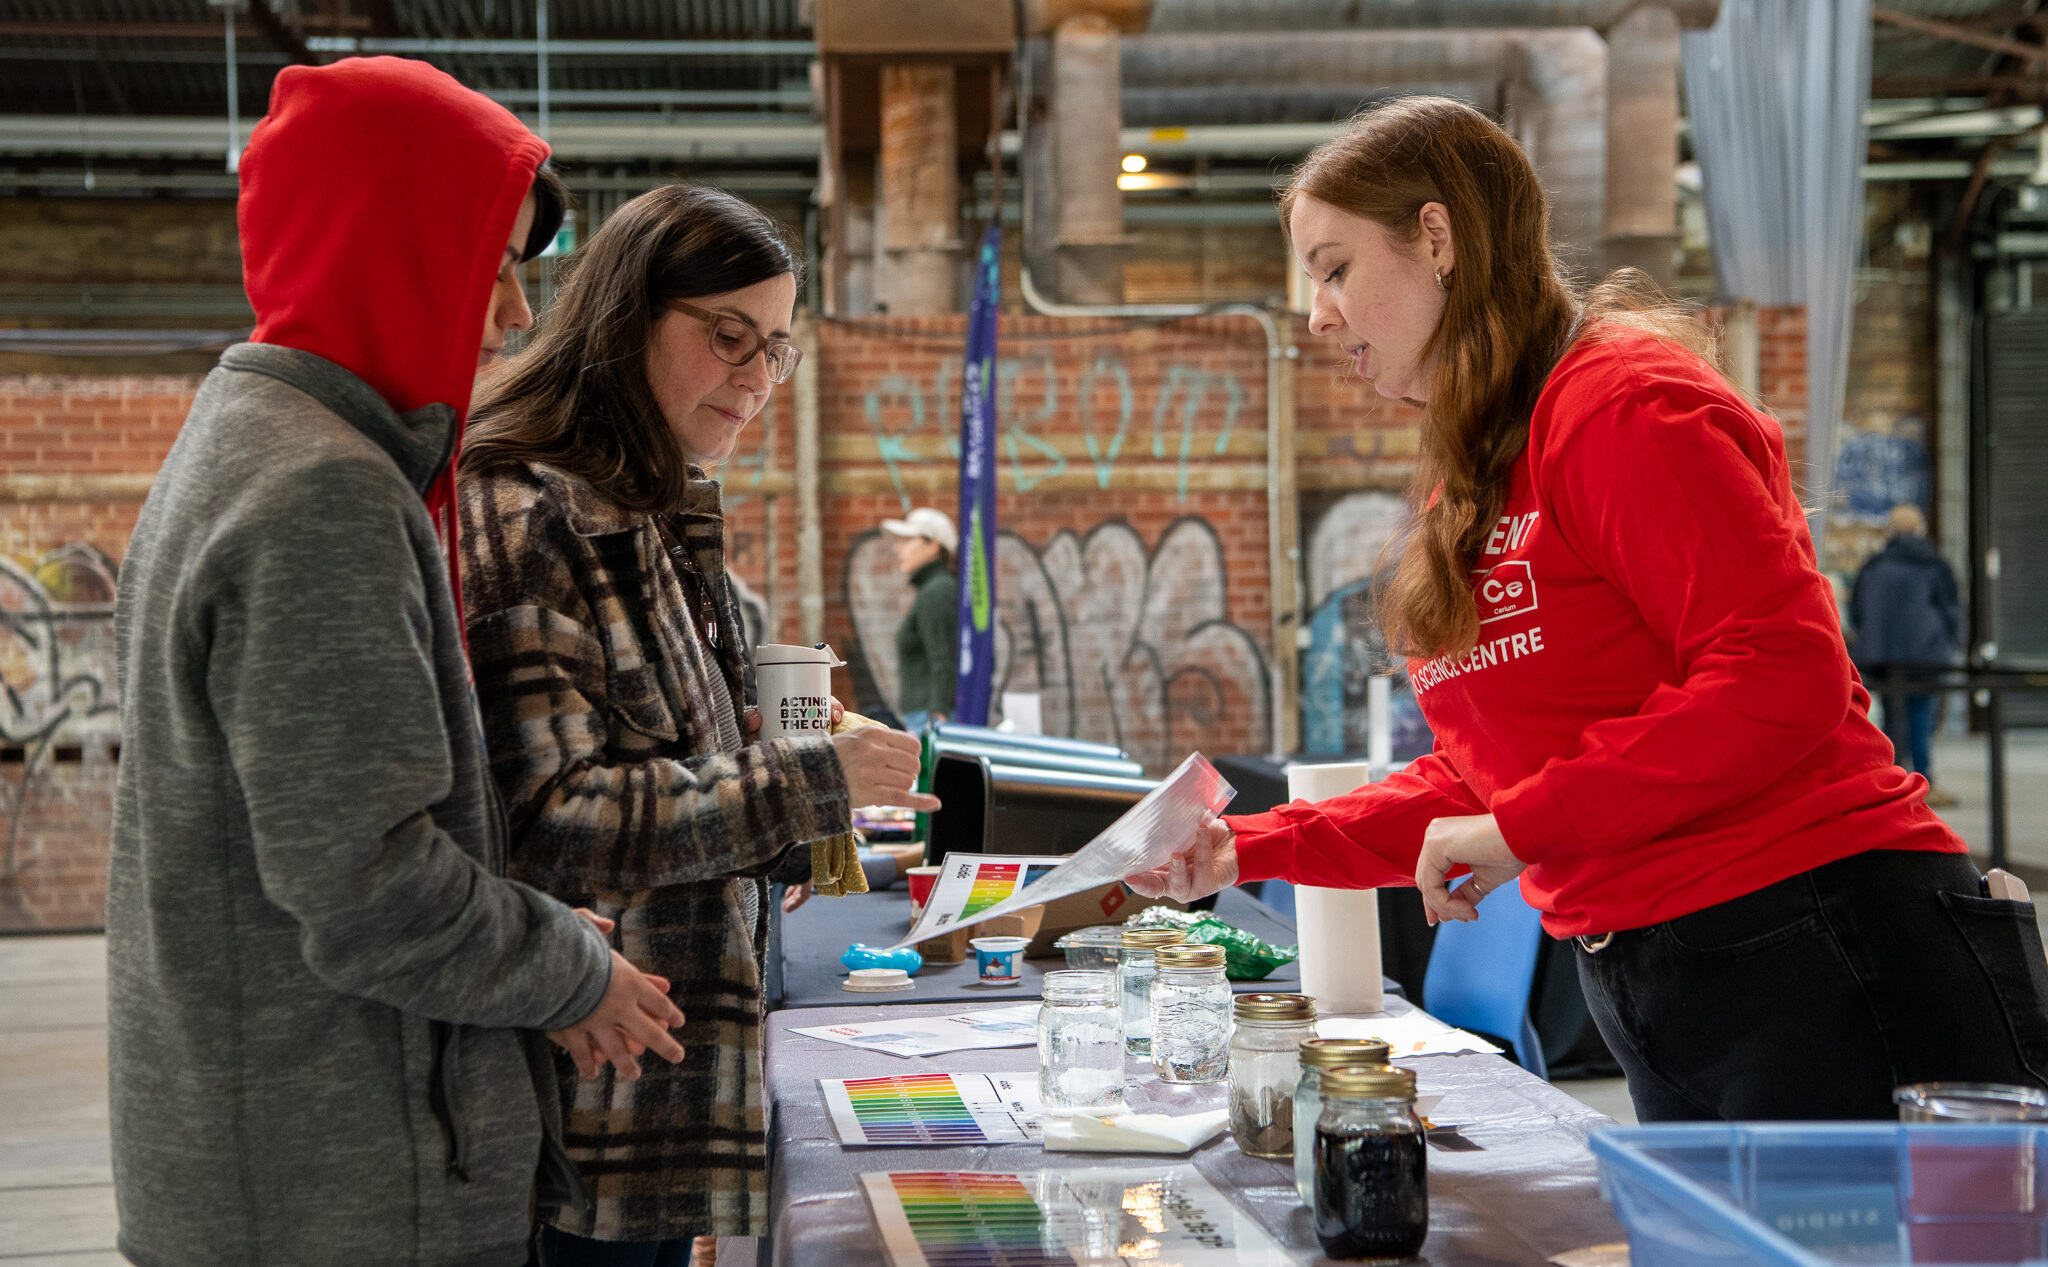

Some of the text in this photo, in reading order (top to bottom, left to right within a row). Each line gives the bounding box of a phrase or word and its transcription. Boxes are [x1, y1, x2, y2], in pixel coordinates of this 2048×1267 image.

[1485, 510, 1540, 555] ENT
[1482, 578, 1524, 604] Ce
[1493, 603, 1517, 615] Cerium
[1418, 653, 1461, 691] SCIENCE
[1457, 626, 1545, 674] CENTRE
[780, 696, 827, 708] ACTING
[780, 719, 809, 730] THE
